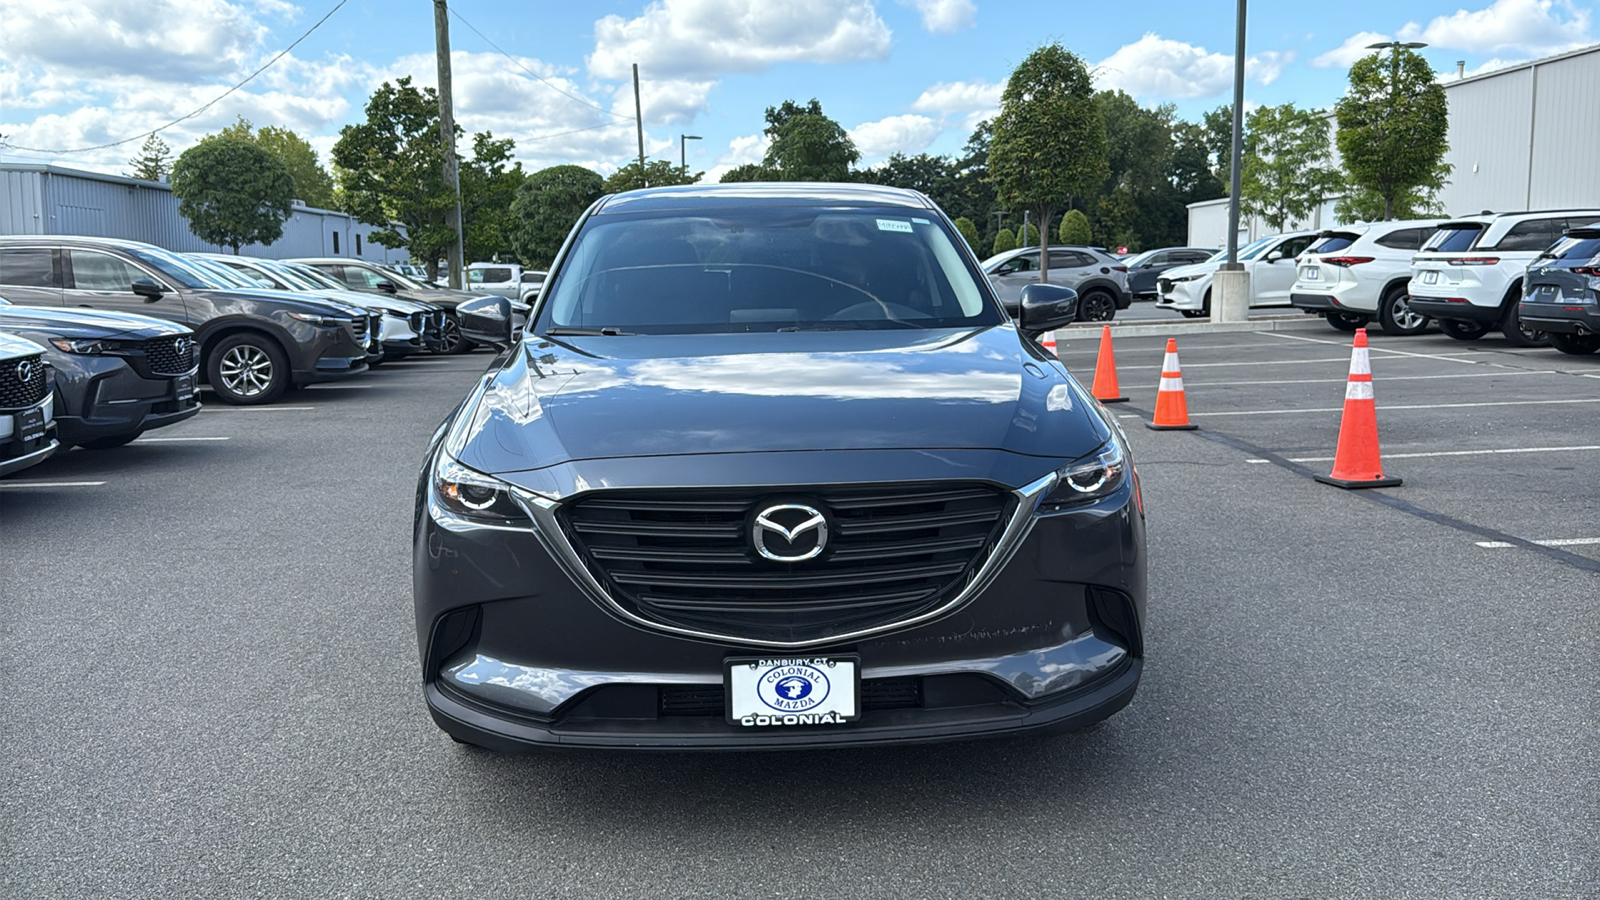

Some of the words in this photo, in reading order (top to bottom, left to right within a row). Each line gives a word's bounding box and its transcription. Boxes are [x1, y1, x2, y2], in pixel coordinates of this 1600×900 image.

[813, 657, 828, 666] CT
[766, 667, 822, 684] COLONIAL
[773, 697, 816, 710] MAZDA
[741, 713, 847, 727] COLONIAL
